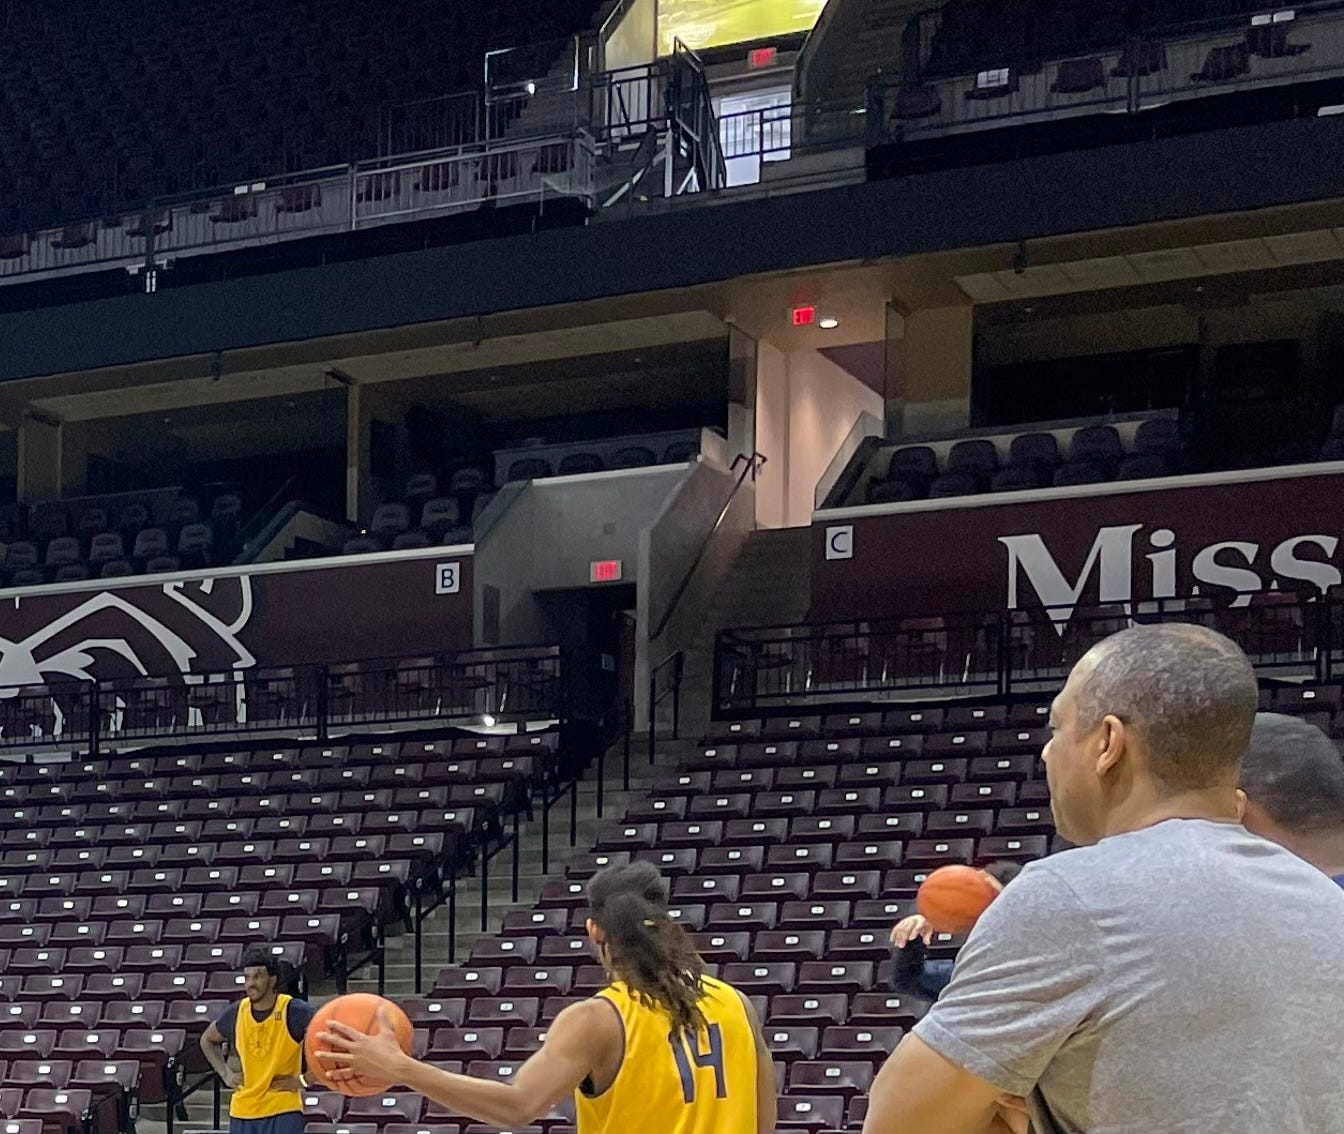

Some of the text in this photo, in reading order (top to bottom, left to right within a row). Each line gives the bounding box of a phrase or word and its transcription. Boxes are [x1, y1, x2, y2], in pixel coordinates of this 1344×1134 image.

[831, 531, 848, 553] C
[441, 568, 455, 588] B
[668, 1022, 727, 1105] 14
